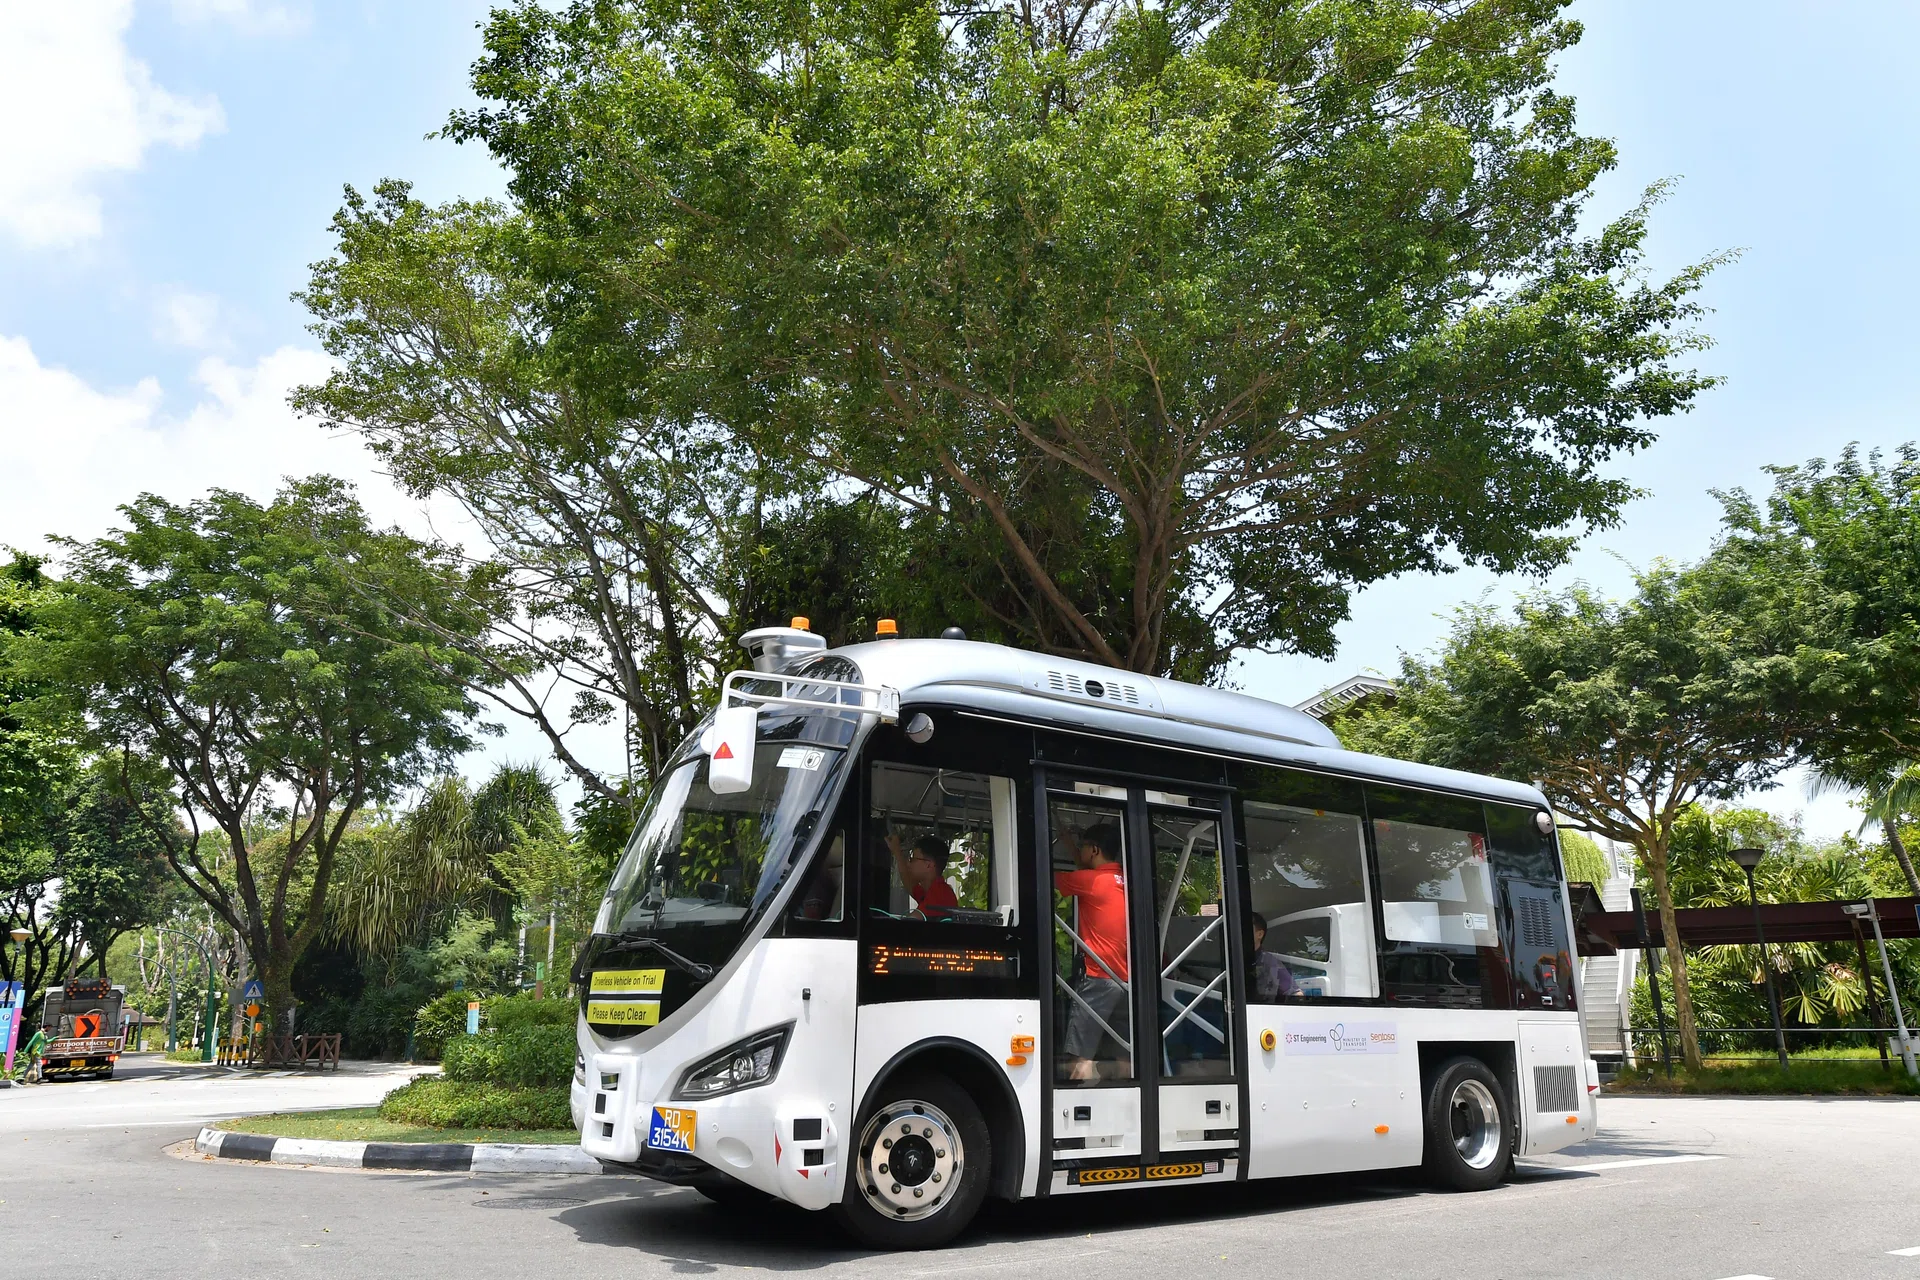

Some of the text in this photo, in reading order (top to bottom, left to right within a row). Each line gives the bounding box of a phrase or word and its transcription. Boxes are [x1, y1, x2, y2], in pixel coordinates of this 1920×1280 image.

[874, 946, 889, 973] 2
[613, 975, 632, 986] Vehicle
[633, 977, 641, 986] on
[642, 974, 657, 985] Trial
[592, 1007, 647, 1023] Please Keep Clear
[1293, 1034, 1327, 1044] ST Engineering
[664, 1109, 681, 1128] RD
[652, 1127, 691, 1150] 3154K
